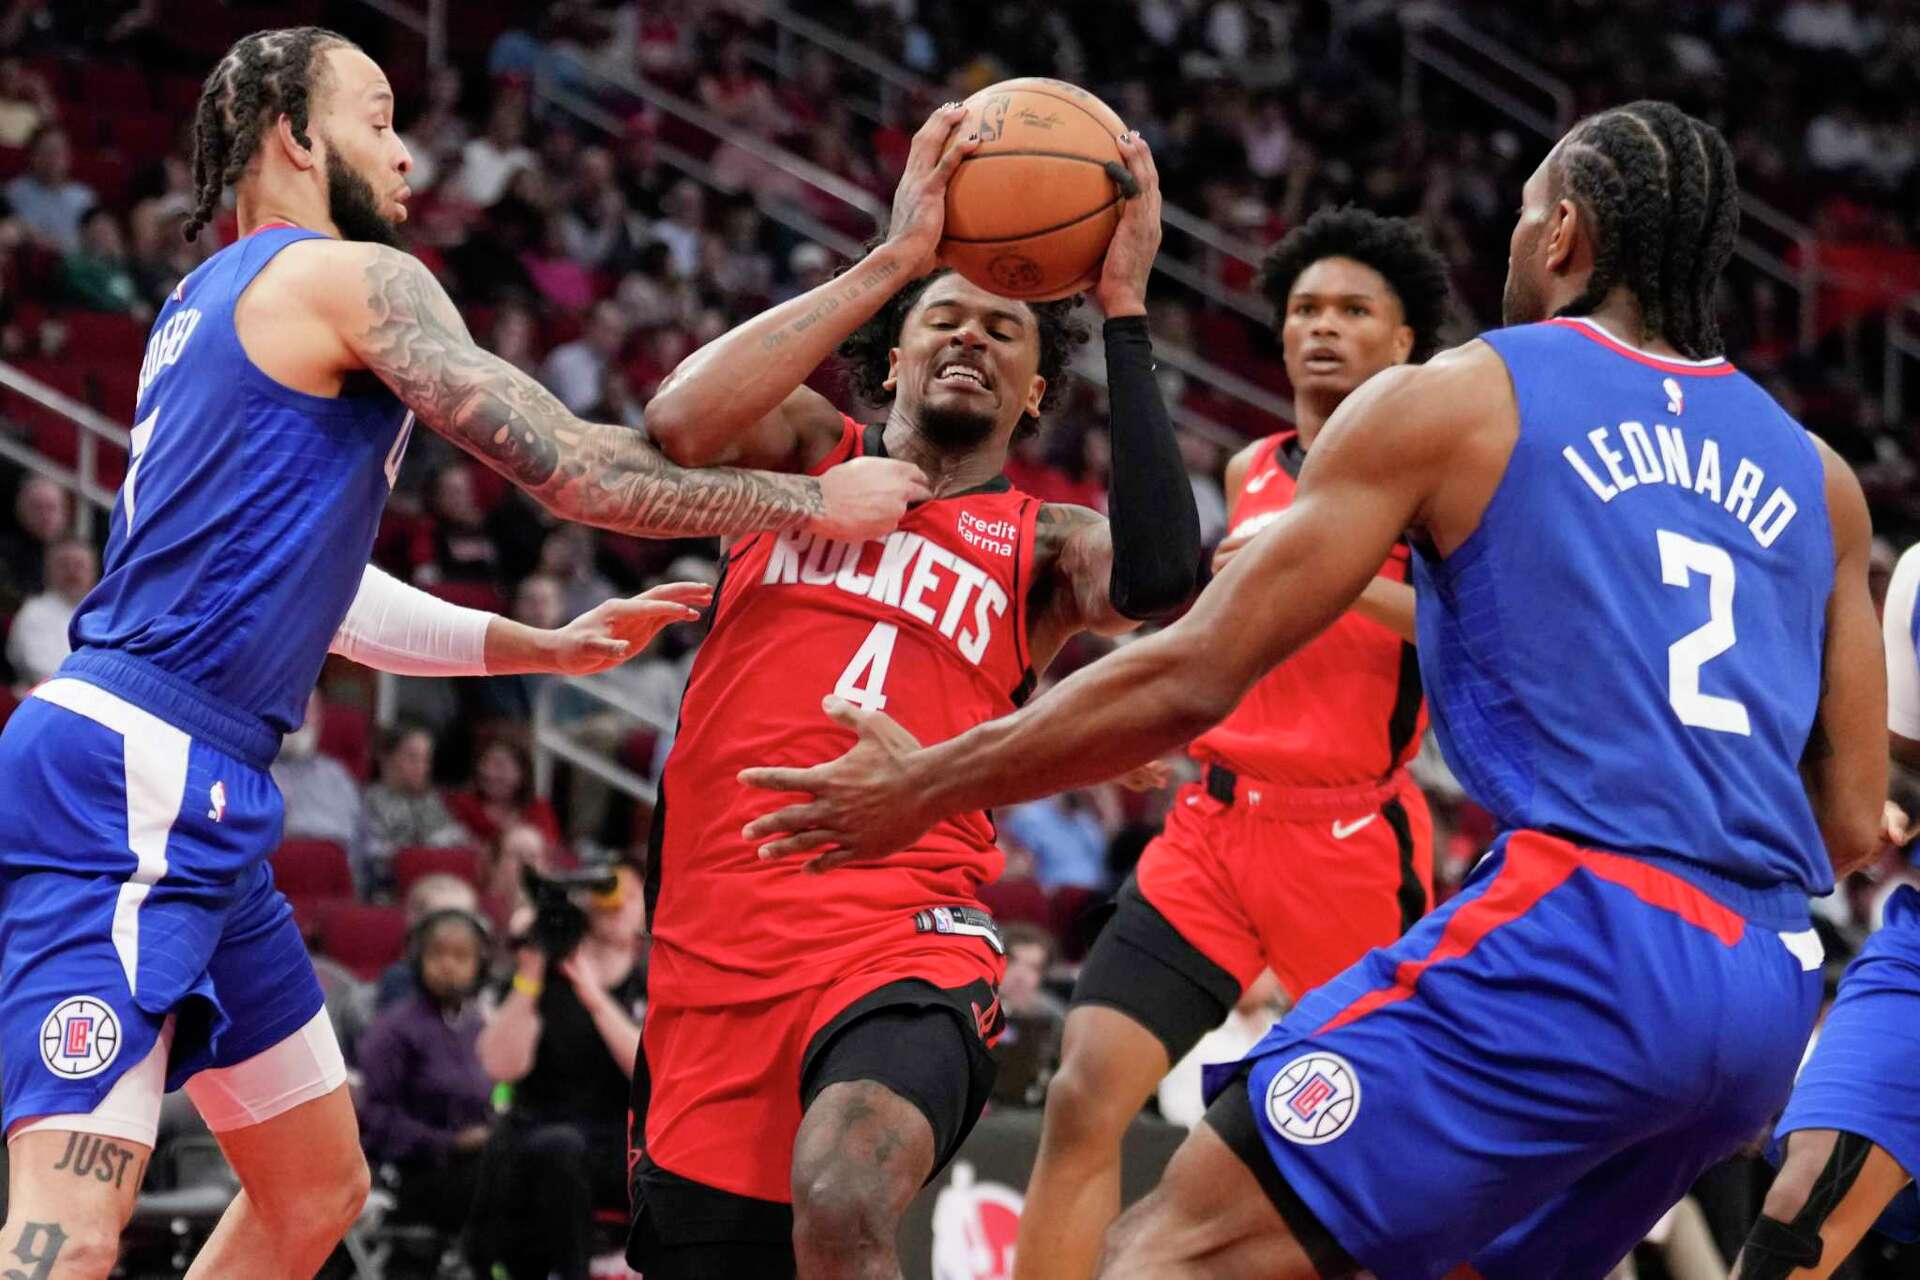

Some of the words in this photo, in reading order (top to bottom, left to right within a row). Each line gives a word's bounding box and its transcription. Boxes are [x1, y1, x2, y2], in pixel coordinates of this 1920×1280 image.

[123, 406, 160, 538] 7
[960, 509, 1017, 541] credit
[1562, 421, 1798, 550] LEONARD
[957, 518, 1013, 558] karma
[761, 529, 1009, 667] ROCKETS
[1656, 529, 1751, 737] 2
[832, 620, 888, 712] 4
[54, 1131, 134, 1190] JUST
